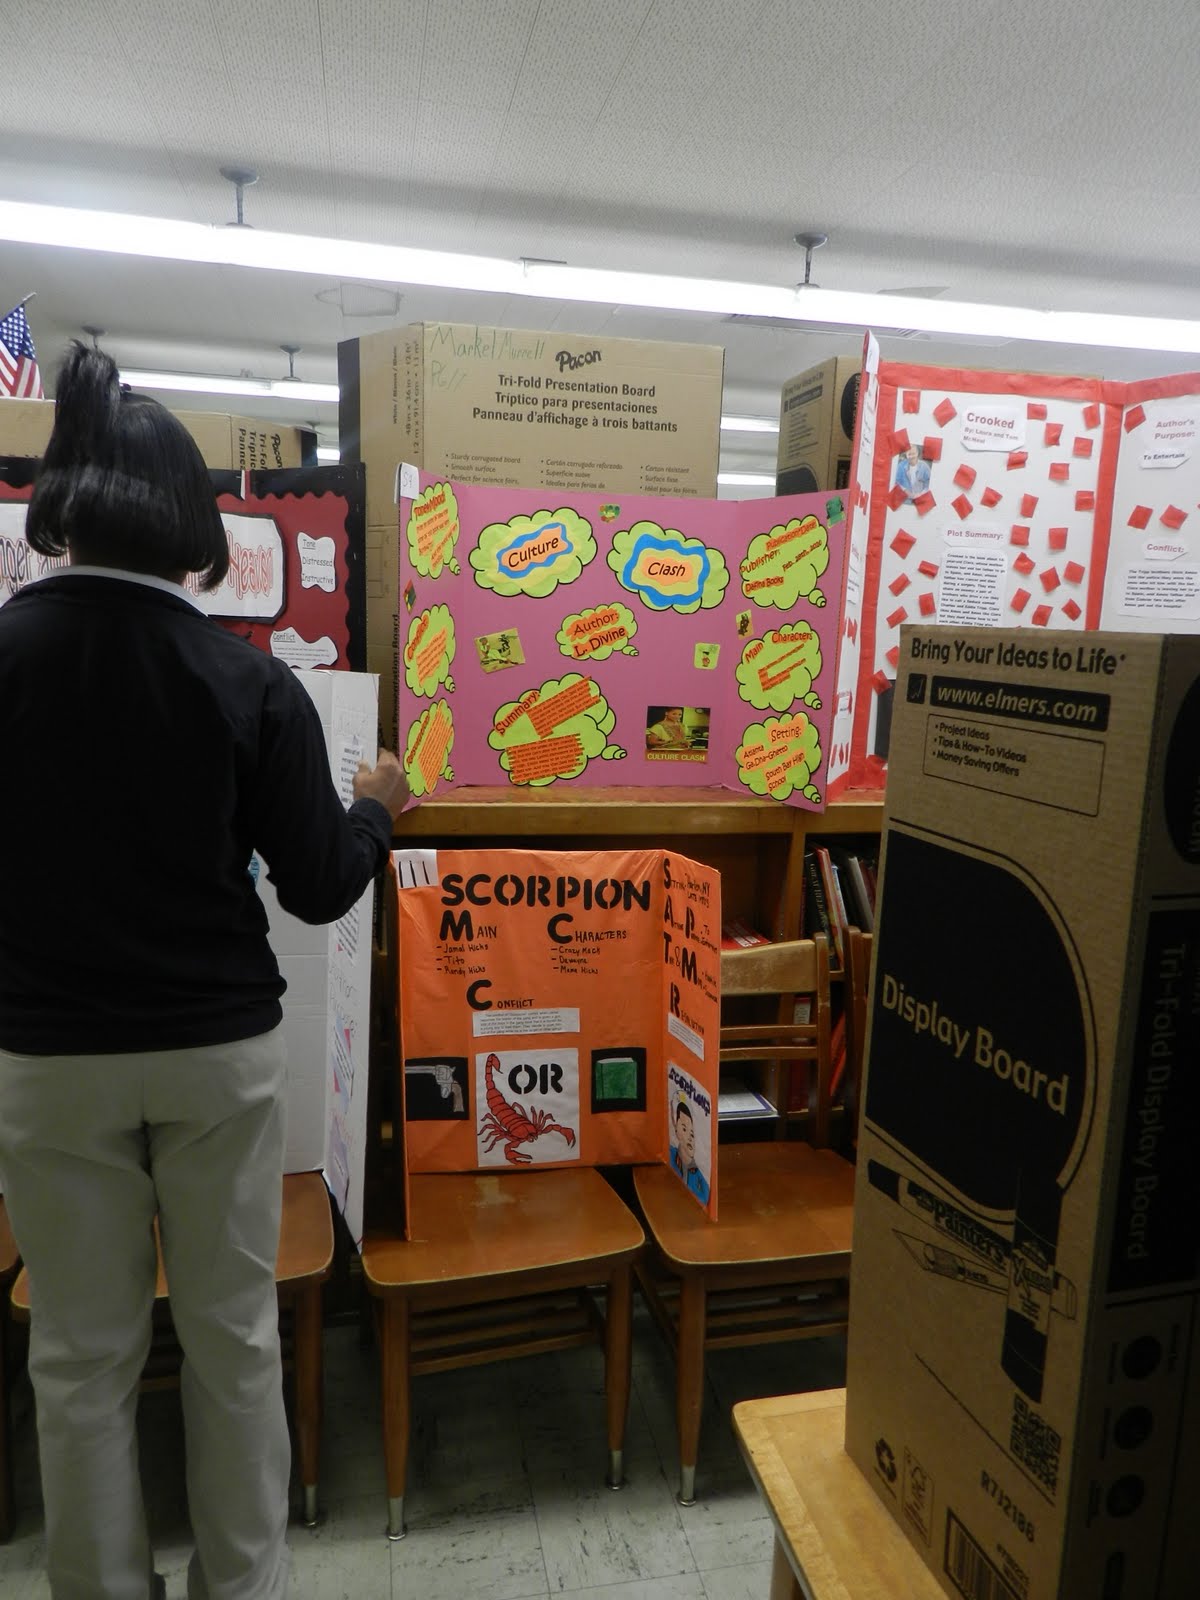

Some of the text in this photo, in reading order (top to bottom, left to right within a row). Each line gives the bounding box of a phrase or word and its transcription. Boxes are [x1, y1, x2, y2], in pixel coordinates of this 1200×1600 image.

[555, 350, 602, 373] Pacon
[498, 374, 656, 398] Tri-Fold Presentation Board
[495, 391, 658, 415] Tríptico para presentaciones
[473, 406, 678, 433] Panneau d'affichage à trois battants
[966, 412, 1015, 429] Crooked
[1155, 419, 1194, 428] Author's
[1154, 432, 1195, 440] Purpose:
[259, 433, 268, 470] Tri-Fol
[271, 433, 283, 468] Pacon
[471, 455, 503, 464] corrugated
[451, 464, 473, 472] Smooth
[451, 474, 471, 482] Perfect
[302, 539, 316, 548] Tone
[965, 531, 1004, 540] Summary:
[508, 537, 559, 568] Culture
[1147, 543, 1184, 553] Conflict:
[302, 557, 333, 567] Distressed
[648, 562, 686, 577] Clash
[739, 549, 781, 573] Publisher:
[302, 573, 334, 585] Instructive
[573, 611, 619, 635] Author:
[273, 632, 295, 641] Conflict
[575, 627, 626, 657] L. Divine
[745, 632, 813, 664] Main Characters
[911, 637, 949, 664] Bring
[953, 640, 994, 665] Your
[997, 642, 1048, 670] Ideas
[1052, 651, 1072, 671] to
[495, 691, 540, 736] Summary:
[937, 684, 1097, 723] www.elmers.com
[771, 726, 802, 743] Setting:
[939, 722, 990, 741] Project Ideas
[647, 753, 706, 762] CULTURE CLASH
[937, 735, 1027, 763] Tips & How-To Videos
[936, 751, 1020, 777] Money Saving Offers
[440, 873, 651, 912] SCORPION
[443, 956, 465, 964] Tito
[558, 946, 580, 955] Crazy
[444, 966, 466, 977] Randy
[882, 973, 1070, 1117] Display Board
[507, 1063, 564, 1096] OR
[1127, 944, 1186, 1261] Tri-Fold Display Board
